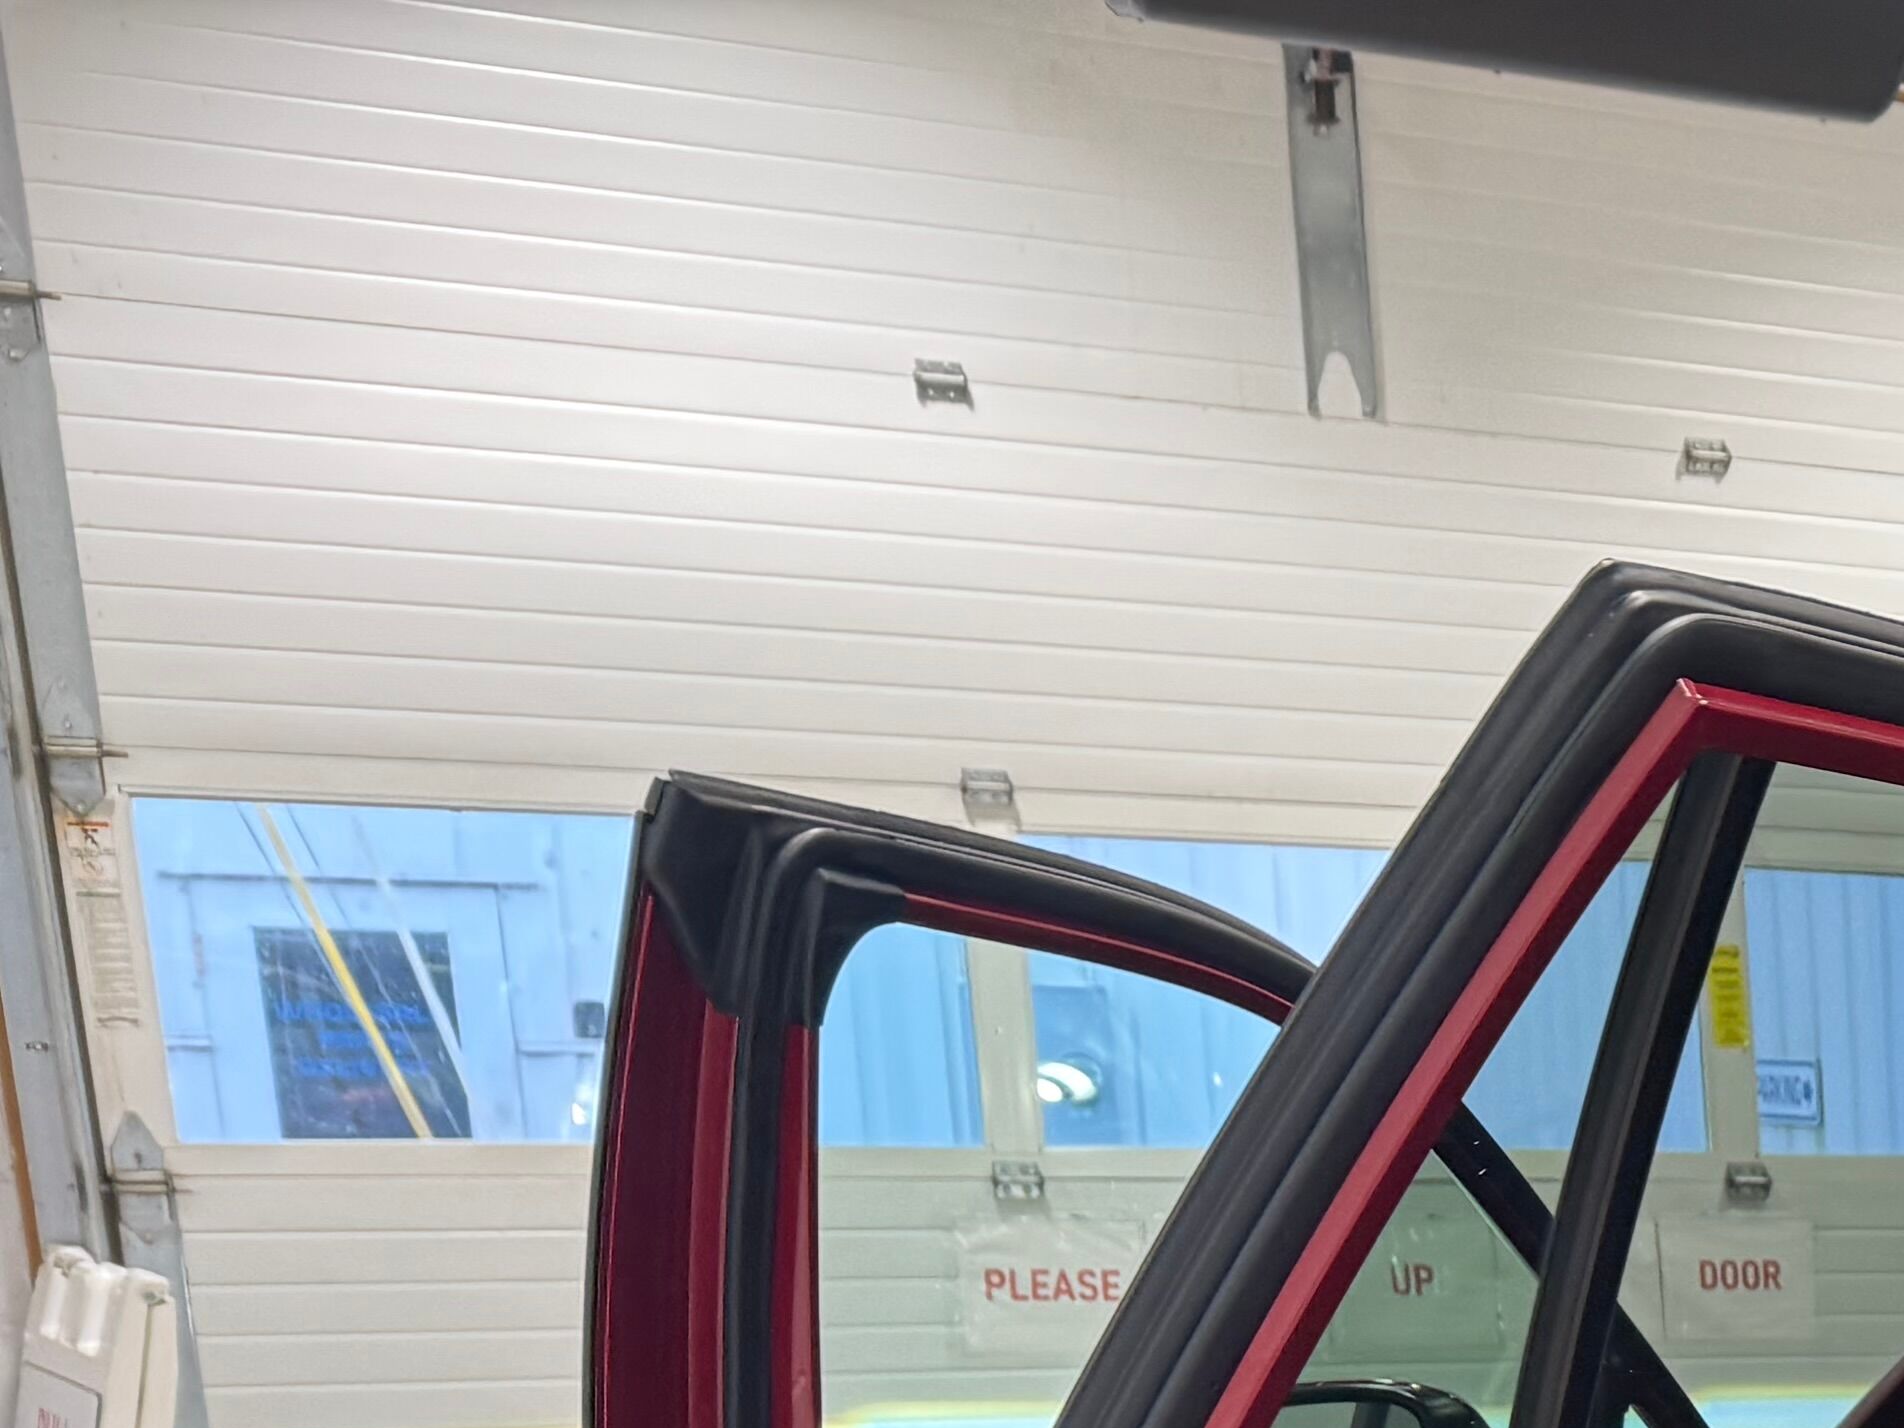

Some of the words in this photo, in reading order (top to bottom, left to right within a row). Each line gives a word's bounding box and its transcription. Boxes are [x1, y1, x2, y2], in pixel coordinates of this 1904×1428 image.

[984, 1268, 1121, 1302] PLEASE
[1391, 1263, 1434, 1296] UP
[1699, 1259, 1782, 1290] DOOR
